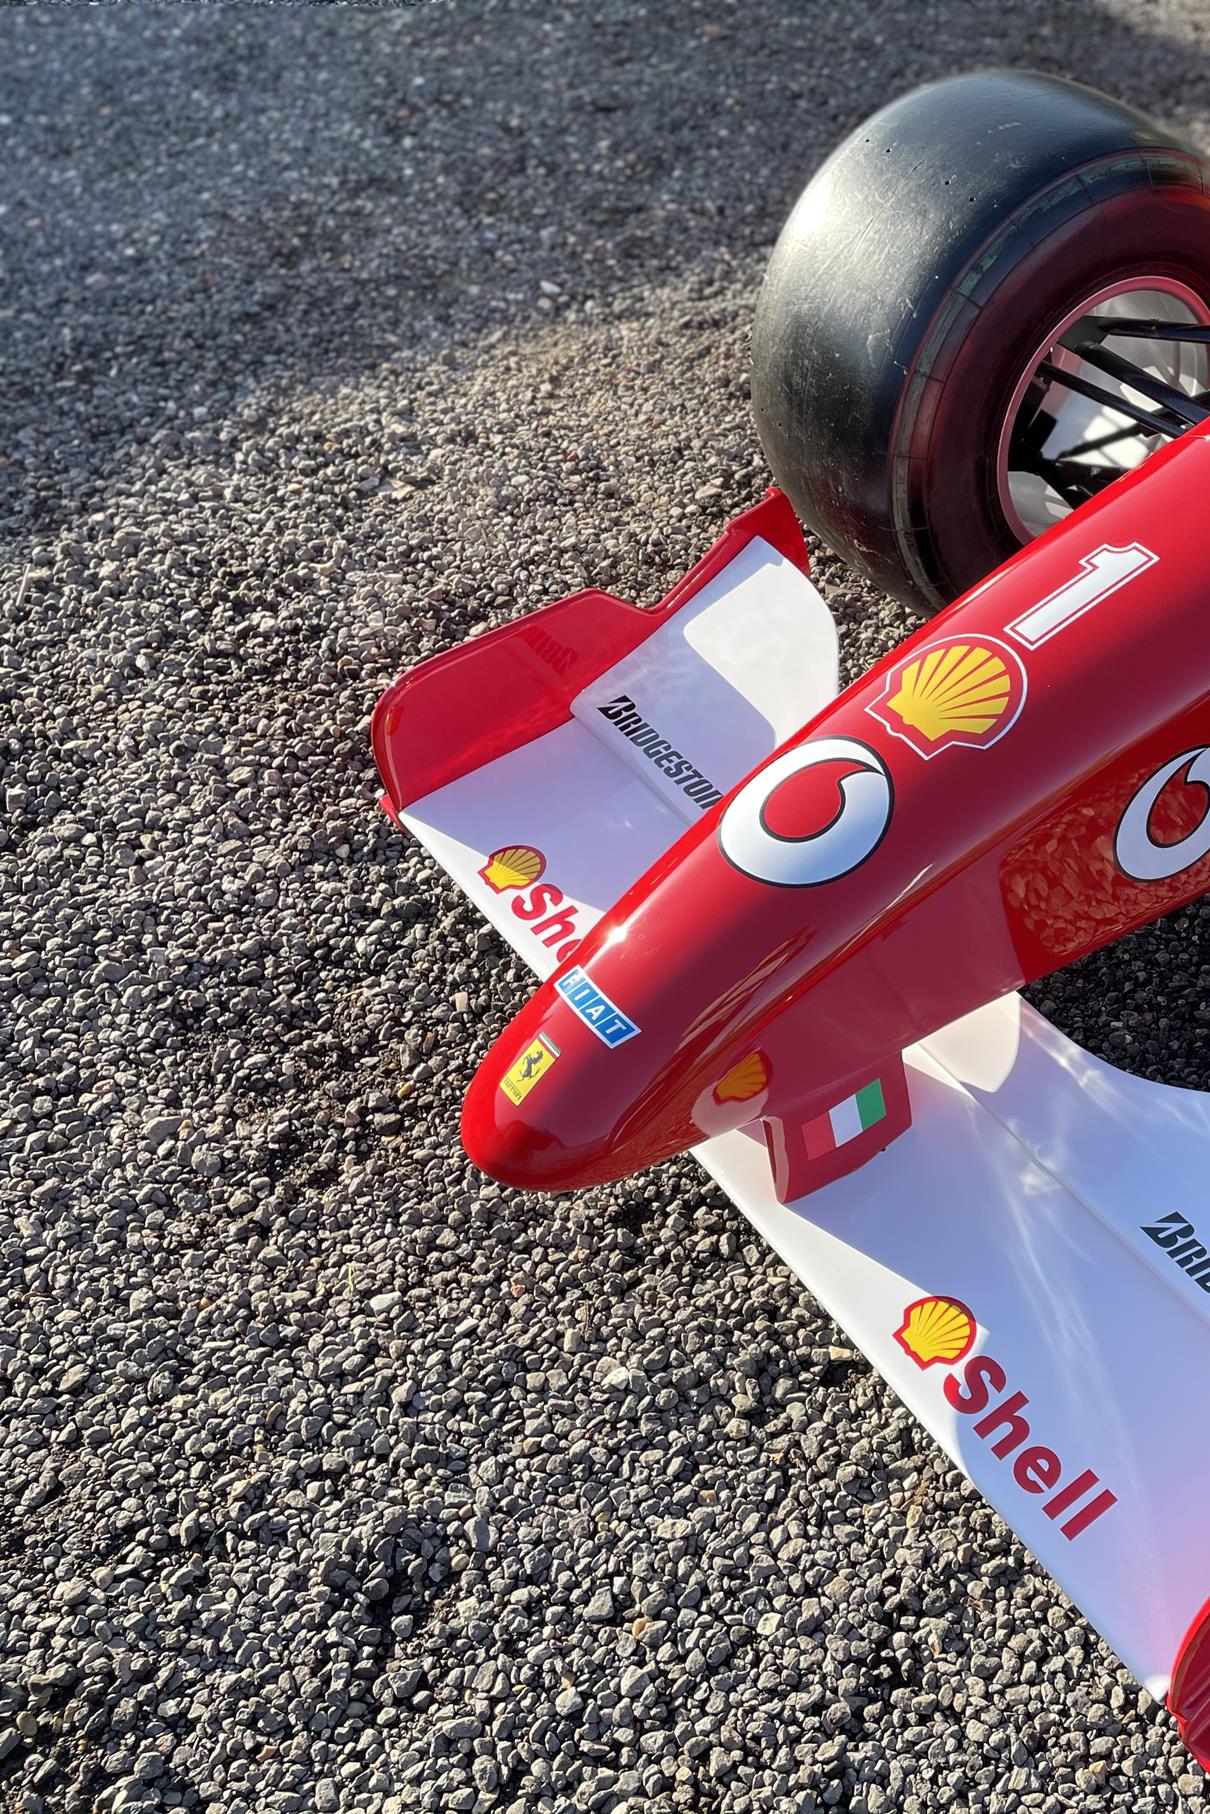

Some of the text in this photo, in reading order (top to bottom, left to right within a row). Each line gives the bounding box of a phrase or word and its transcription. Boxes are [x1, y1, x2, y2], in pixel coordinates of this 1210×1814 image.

[1003, 541, 1161, 651] 1
[562, 971, 627, 1035] FIAT
[943, 1355, 1119, 1542] Shell
